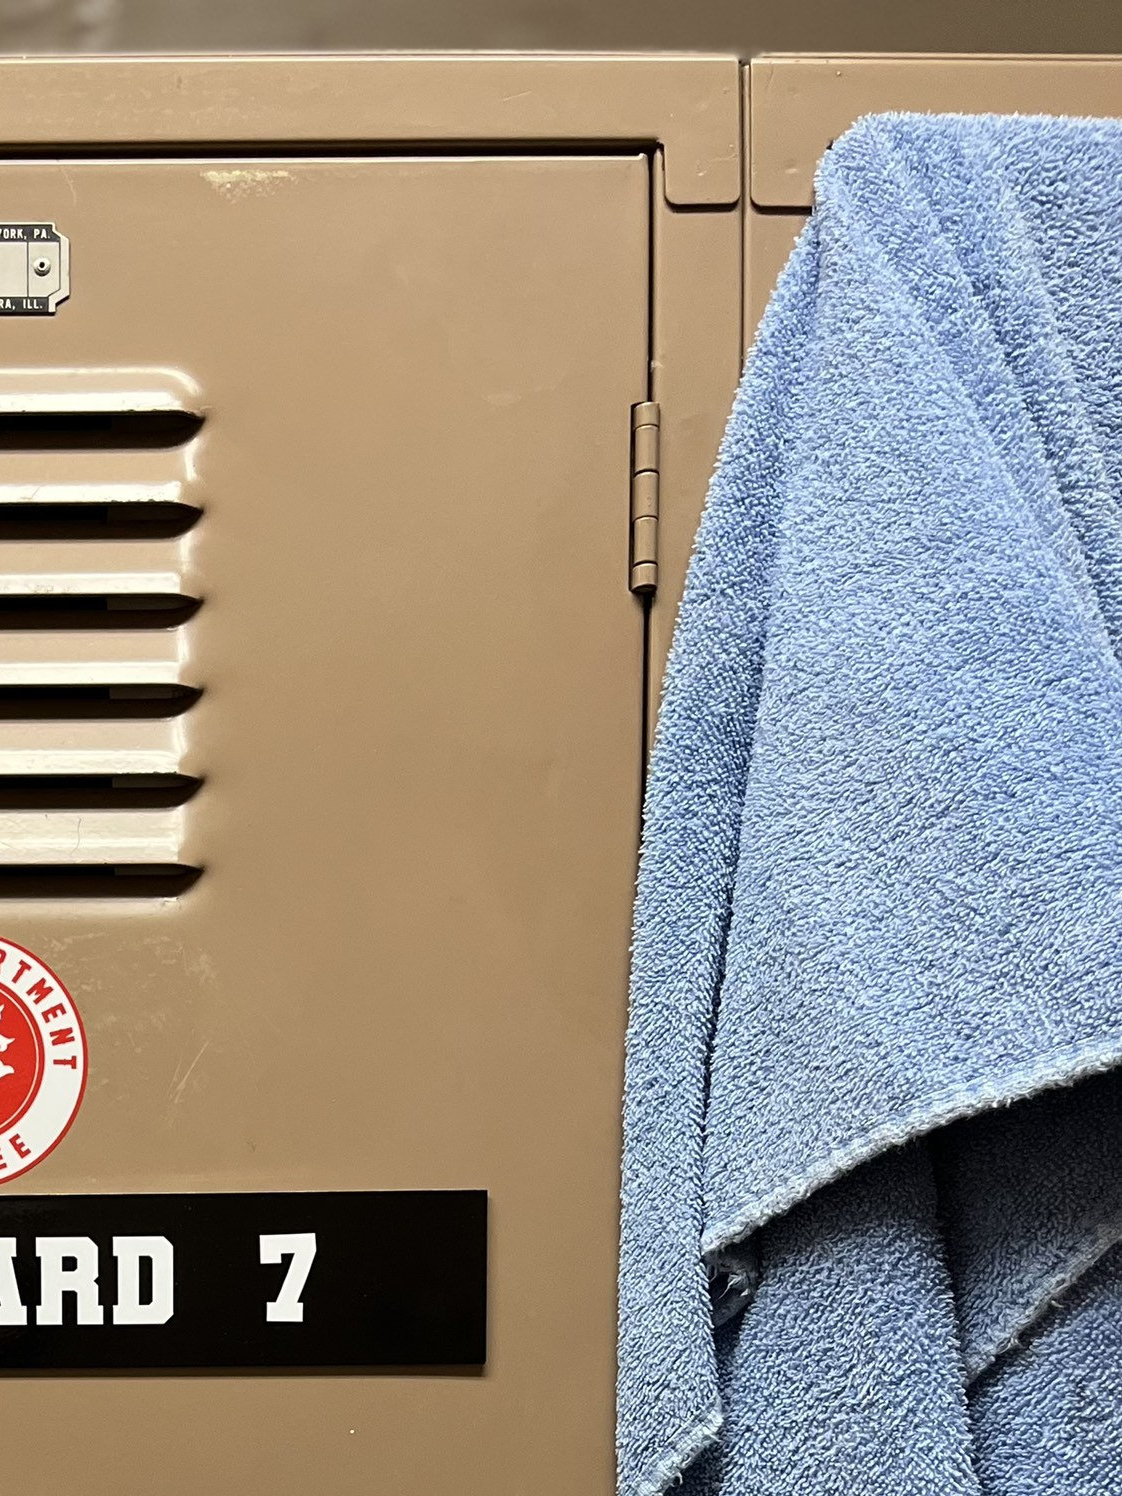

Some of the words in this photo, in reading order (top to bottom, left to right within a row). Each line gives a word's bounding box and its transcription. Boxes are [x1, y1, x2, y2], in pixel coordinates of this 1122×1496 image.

[33, 228, 51, 239] PA.
[22, 298, 43, 310] ILL.
[259, 1232, 317, 1323] 7
